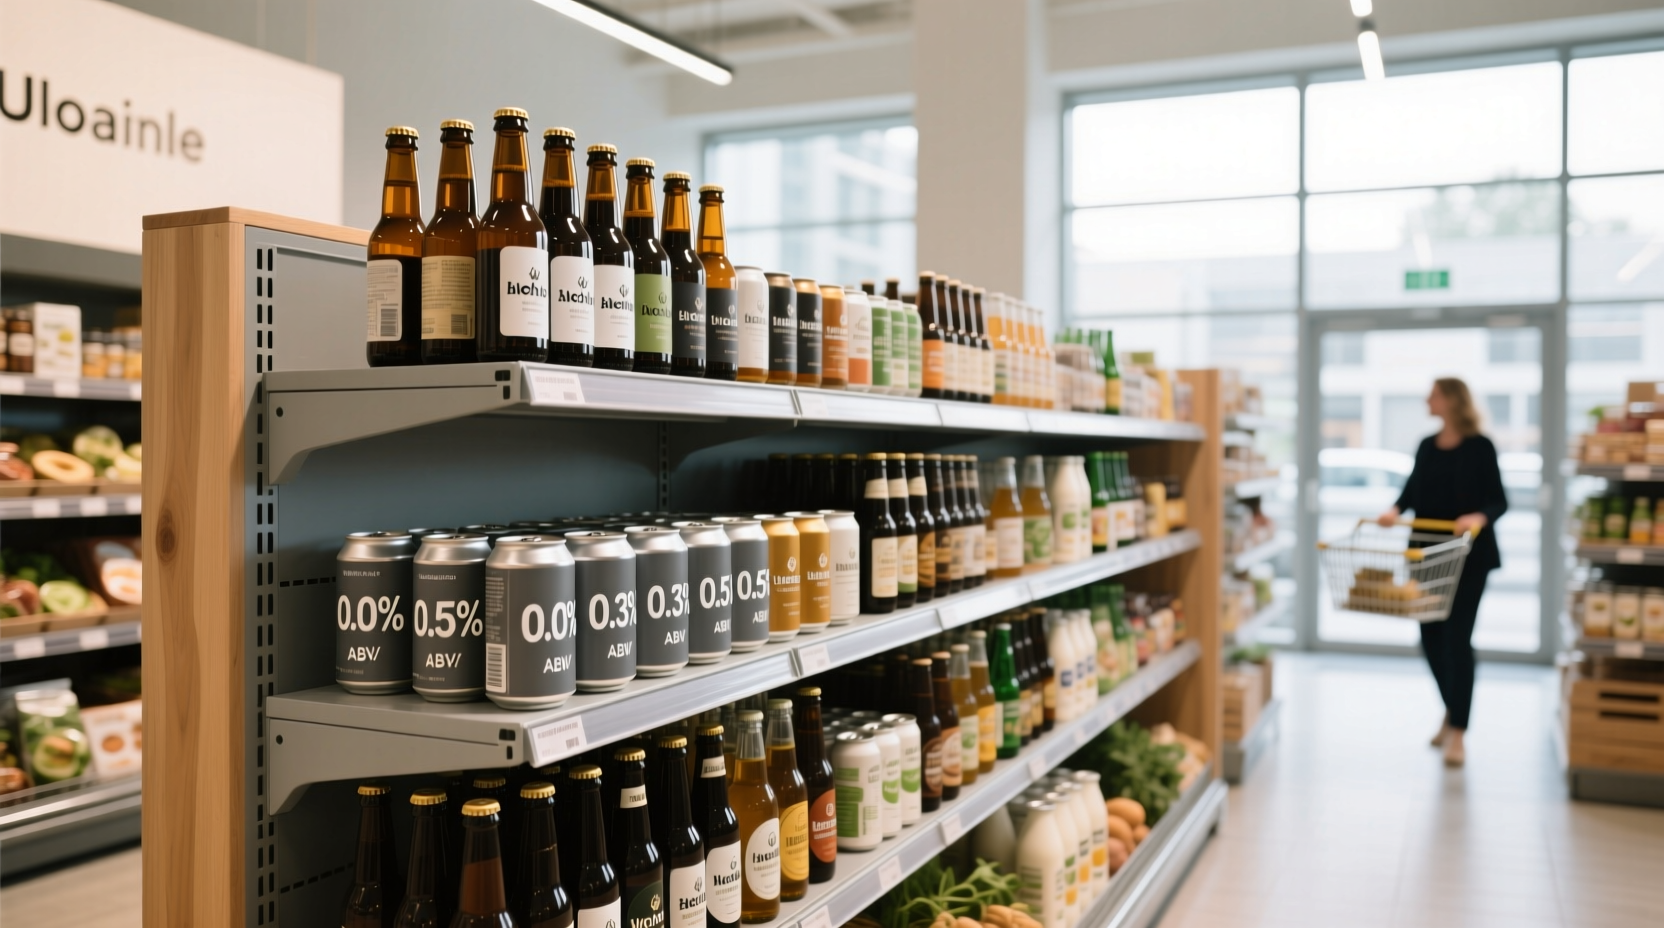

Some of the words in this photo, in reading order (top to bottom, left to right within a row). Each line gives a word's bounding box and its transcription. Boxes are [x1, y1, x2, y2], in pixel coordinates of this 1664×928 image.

[699, 573, 734, 609] 0.5
[737, 568, 770, 601] 0.5
[337, 594, 405, 632] 0.0%
[414, 599, 484, 638] 0.5%
